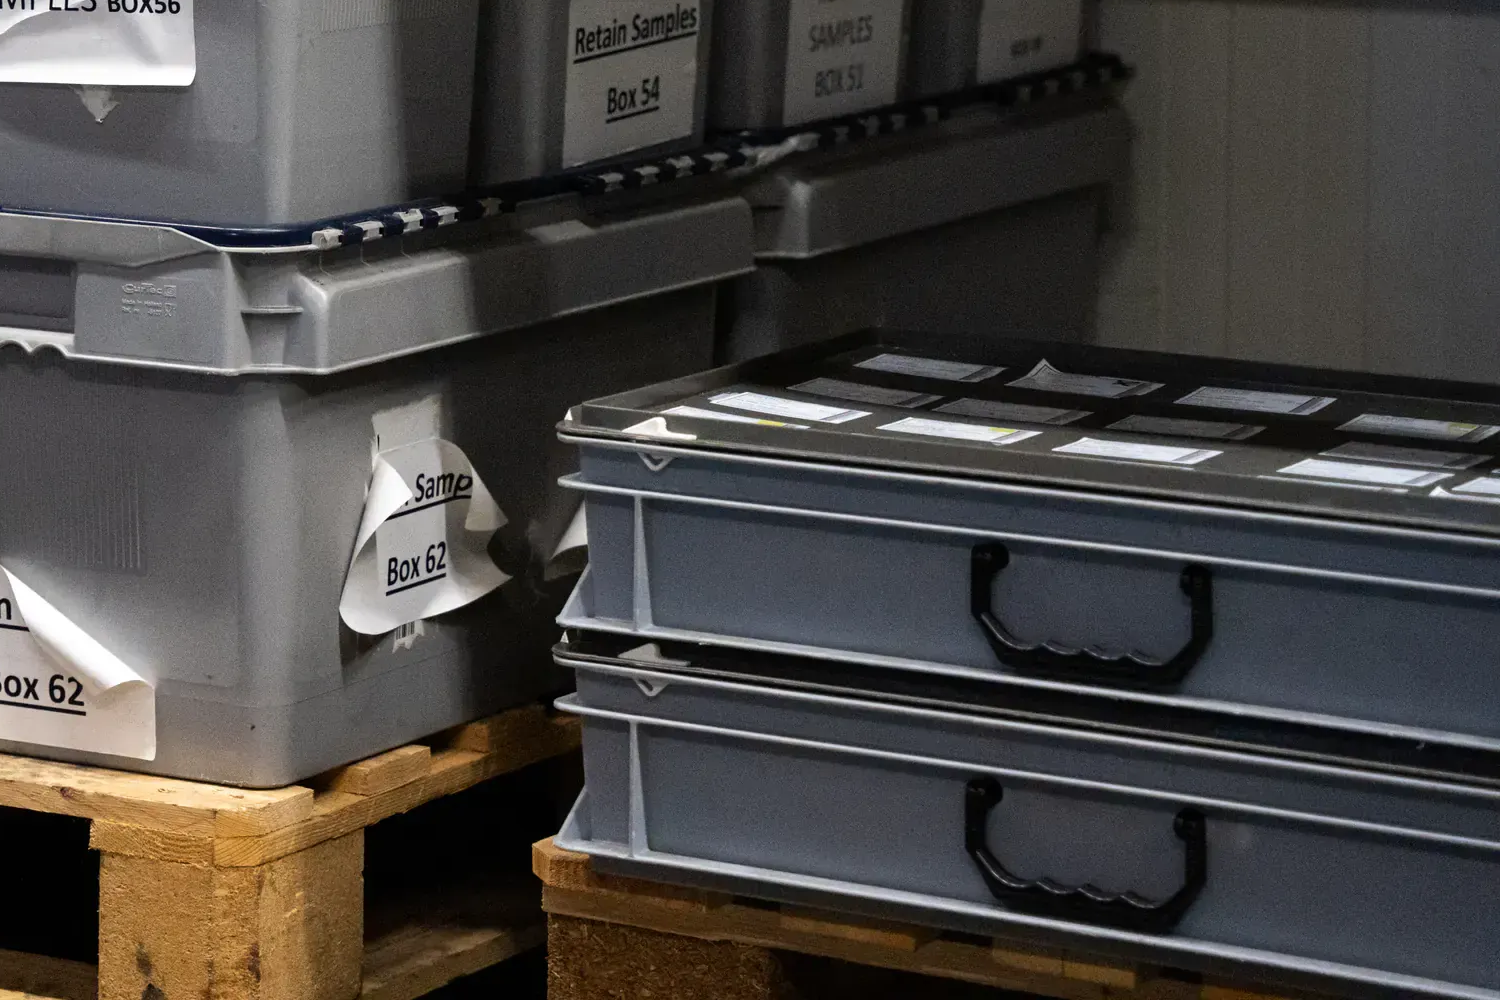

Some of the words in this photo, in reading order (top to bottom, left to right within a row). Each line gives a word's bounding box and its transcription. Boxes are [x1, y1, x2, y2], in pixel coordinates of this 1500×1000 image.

[575, 18, 628, 56] Retain
[631, 4, 697, 41] Samples
[607, 87, 637, 115] Box
[641, 75, 660, 105] 54
[387, 555, 422, 587] Box
[425, 541, 447, 574] 62
[48, 674, 85, 707] 62
